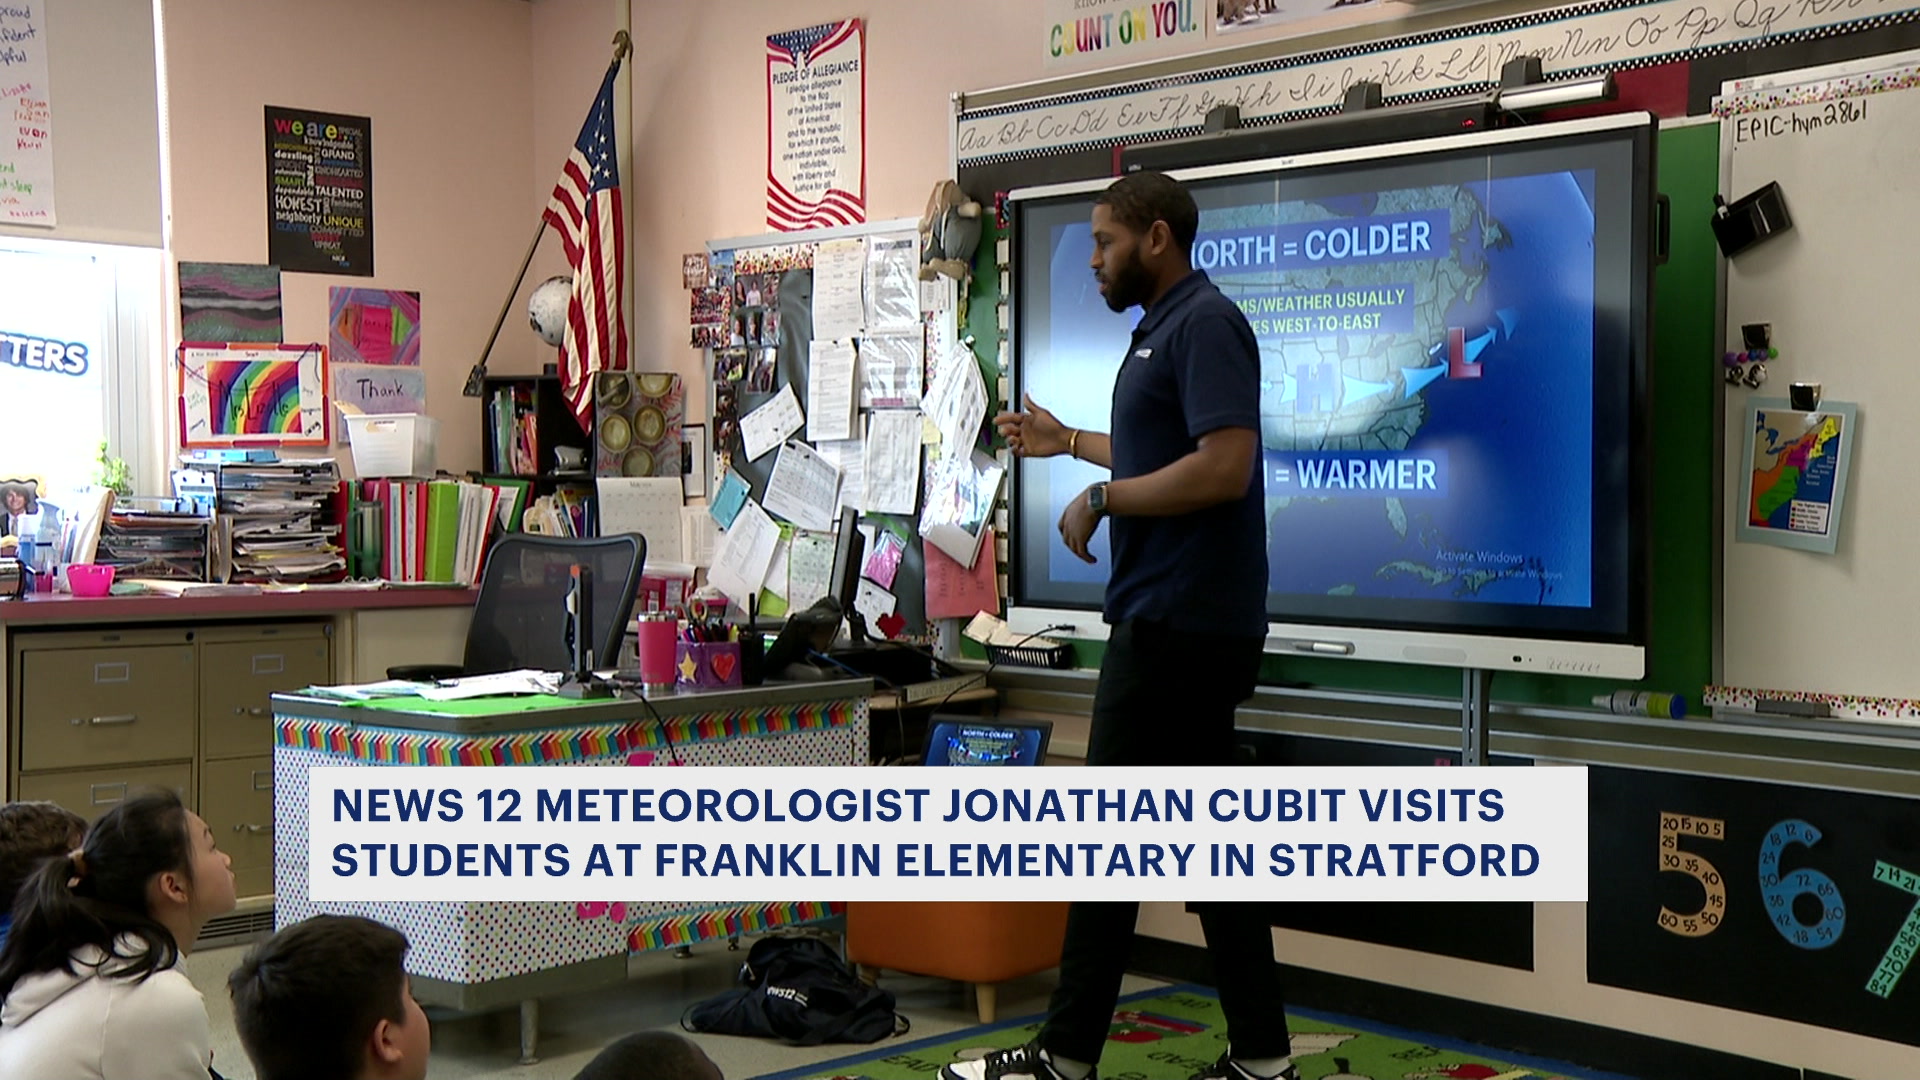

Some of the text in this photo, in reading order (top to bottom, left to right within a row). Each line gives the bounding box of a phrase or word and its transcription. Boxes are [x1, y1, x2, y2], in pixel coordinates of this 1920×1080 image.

[1050, 13, 1113, 57] COUNT
[1119, 7, 1147, 45] ON
[772, 59, 859, 84] PLEDGE OF ALLEGIANCE
[960, 127, 993, 151] Aa
[999, 118, 1033, 145] Bb
[1037, 115, 1069, 140] Cc
[1070, 108, 1109, 134] Dd
[1435, 44, 1487, 80] Ll
[1626, 15, 1668, 47] Oo
[1675, 6, 1727, 50] Pp
[1734, 0, 1790, 36] Qq
[274, 118, 304, 136] we
[315, 186, 364, 199] TALENTED
[275, 194, 322, 213] HONEST
[323, 215, 364, 229] UNIQUE
[1305, 220, 1432, 261] COLDER
[1335, 289, 1406, 310] USUALLY
[356, 378, 404, 400] Thank
[1297, 458, 1437, 490] WARMER
[1435, 550, 1524, 564] Activate Windows
[988, 730, 1014, 739] COLDER
[1662, 817, 1721, 836] 20 15 10 5
[1662, 835, 1675, 849] 25
[1663, 854, 1680, 868] 30
[1685, 858, 1699, 872] 35
[1876, 866, 1885, 878] 7
[1903, 877, 1916, 891] 21
[1661, 914, 1678, 928] 60
[1683, 919, 1698, 932] 55
[1701, 911, 1719, 926] 50
[1899, 931, 1917, 948] 56
[1892, 944, 1911, 961] 63
[1885, 955, 1904, 973] 70
[1878, 968, 1895, 984] 77
